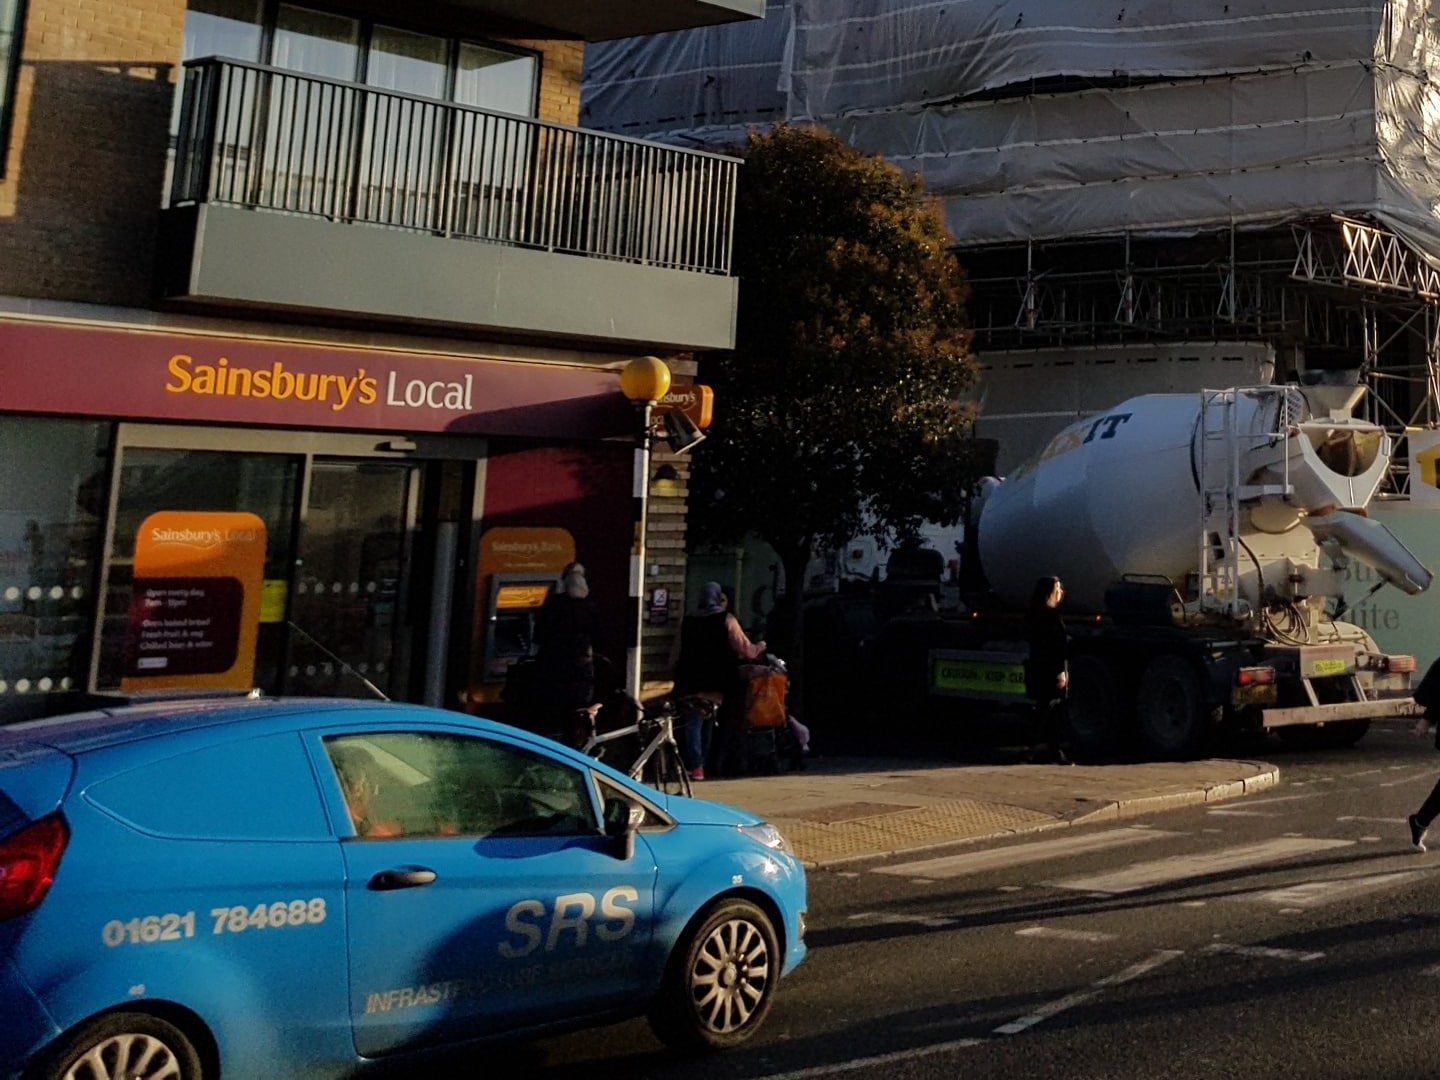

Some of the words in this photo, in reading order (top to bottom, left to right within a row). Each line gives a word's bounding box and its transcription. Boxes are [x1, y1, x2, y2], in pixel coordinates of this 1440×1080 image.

[166, 354, 377, 411] Sainsbury's
[386, 371, 473, 410] Local
[152, 527, 221, 543] Sainsbury's
[225, 529, 257, 541] Local
[102, 911, 196, 947] 01621
[210, 897, 327, 935] 784688
[499, 886, 640, 959] SRS
